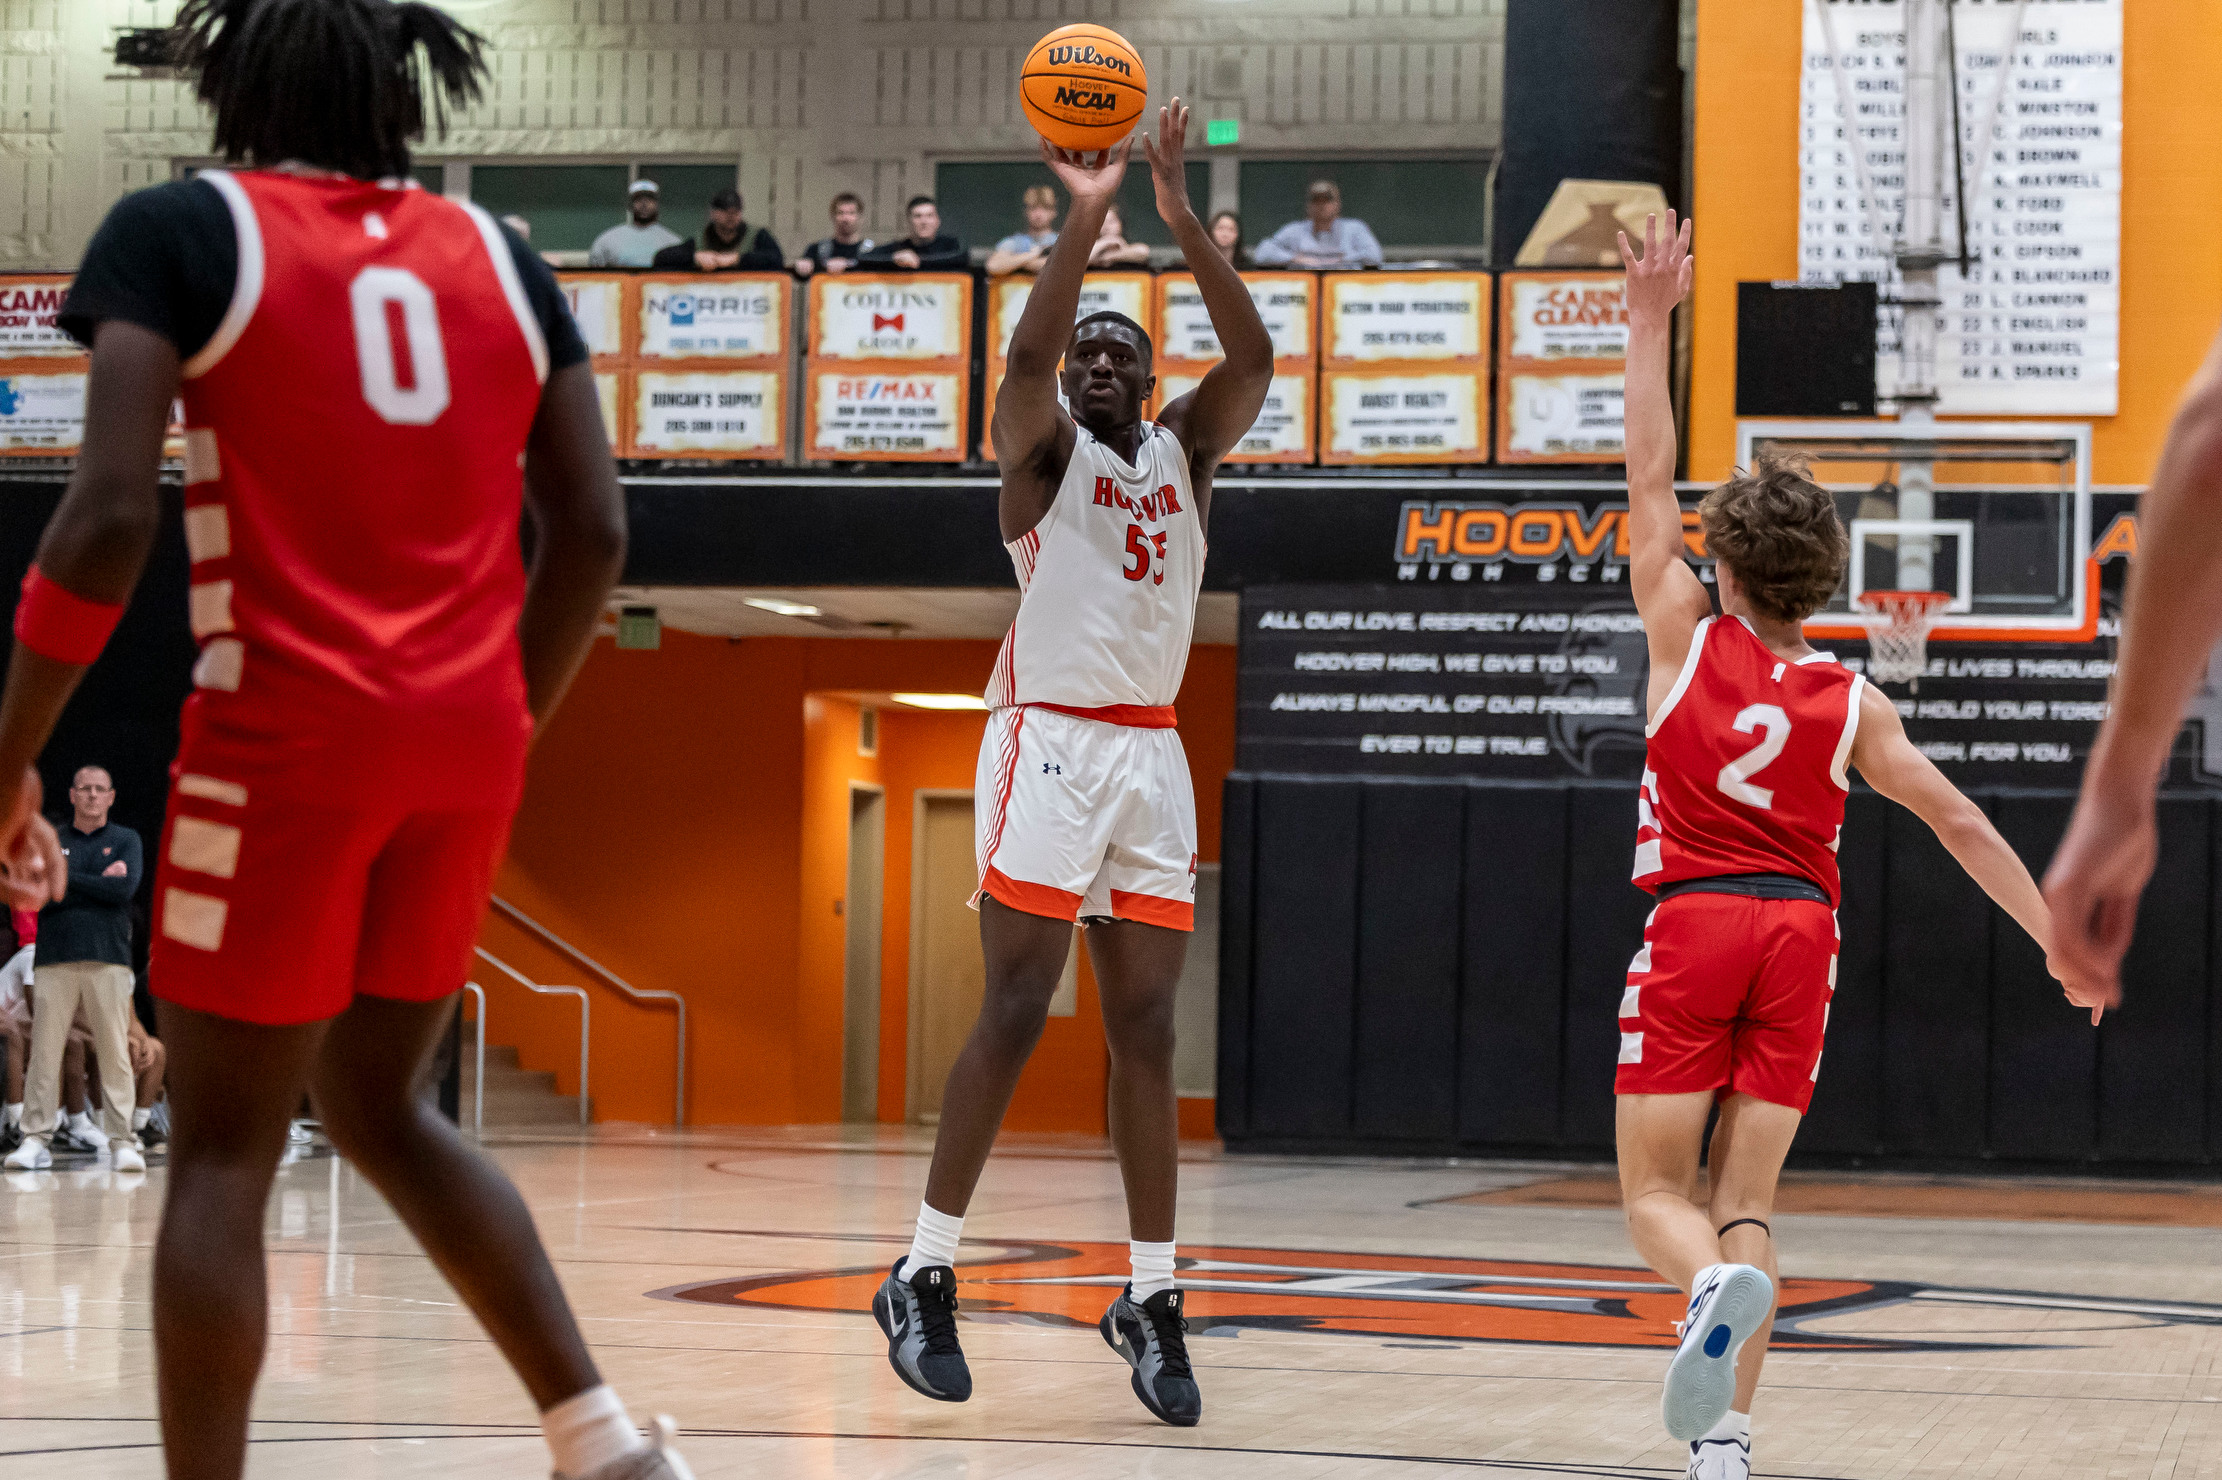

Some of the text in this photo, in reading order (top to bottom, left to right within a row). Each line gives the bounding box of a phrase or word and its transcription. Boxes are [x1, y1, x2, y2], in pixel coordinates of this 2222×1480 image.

[1048, 44, 1131, 78] Wilson
[1053, 86, 1116, 111] NCAA
[2018, 149, 2080, 164] BROWN
[648, 294, 771, 317] NORRIS
[842, 291, 937, 309] COLLINS
[349, 265, 452, 427] 0
[837, 381, 936, 401] RE/MAX
[1123, 523, 1167, 587] 55
[1397, 563, 1504, 583] HIGH
[1257, 611, 1302, 631] ALL
[1303, 611, 1353, 631] OUR
[1418, 612, 1520, 632] RESPECT
[1519, 612, 1570, 633] AND
[1294, 652, 1386, 672] HOOVER
[1444, 653, 1483, 674] WE
[1482, 653, 1536, 673] GIVE
[1536, 653, 1568, 674] TO
[1946, 656, 2015, 679] LIVES
[1269, 692, 1357, 712] ALWAYS
[1357, 693, 1452, 714] MINDFUL
[1452, 694, 1487, 714] OF
[1486, 694, 1538, 714] OUR
[1915, 699, 1982, 720] HOLD
[1982, 700, 2048, 721] YOUR
[1359, 734, 1423, 754] EVER
[1423, 735, 1454, 755] TO
[1453, 735, 1487, 755] BE
[1968, 742, 2020, 763] FOR
[1717, 703, 1792, 810] 2
